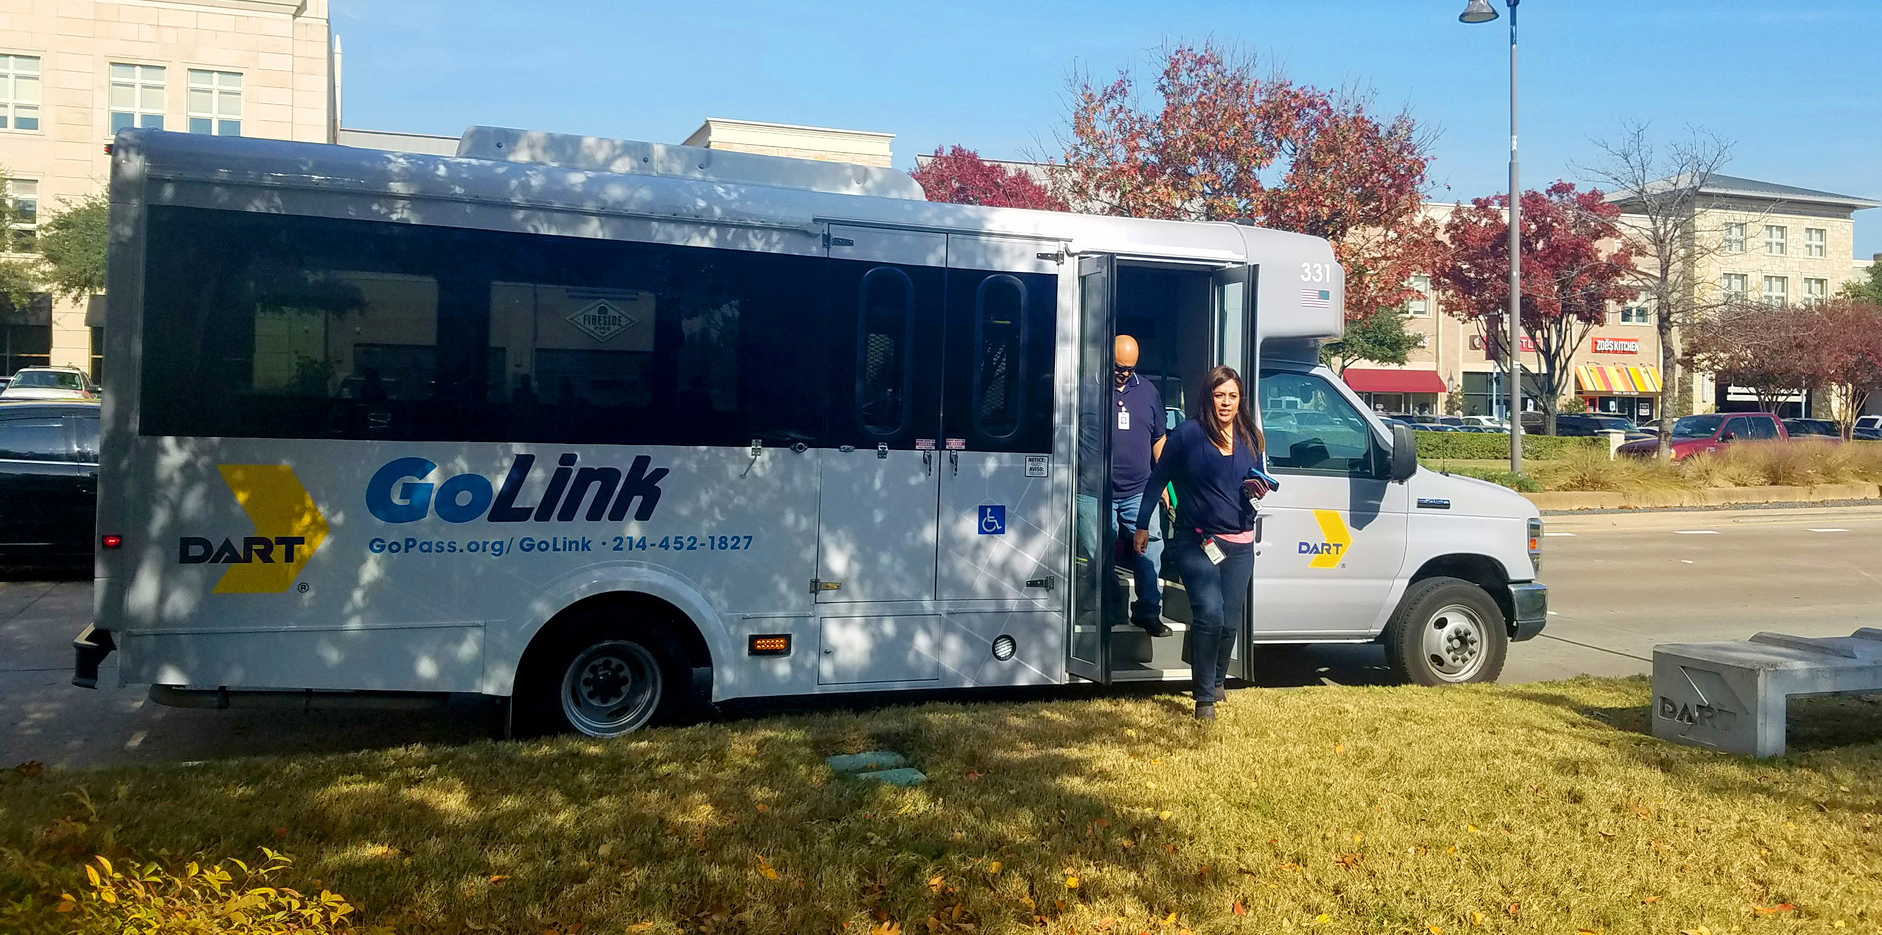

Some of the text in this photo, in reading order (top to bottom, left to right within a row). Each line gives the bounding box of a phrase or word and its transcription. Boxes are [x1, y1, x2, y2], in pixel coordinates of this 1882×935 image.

[1300, 261, 1330, 284] 331
[582, 314, 623, 327] FIRESIDE
[1613, 340, 1640, 352] KITCHEN
[365, 452, 670, 524] GoLink
[178, 536, 306, 565] DART
[612, 535, 753, 551] 214-452-1827
[1298, 541, 1343, 555] DART
[1658, 695, 1737, 733] DART
